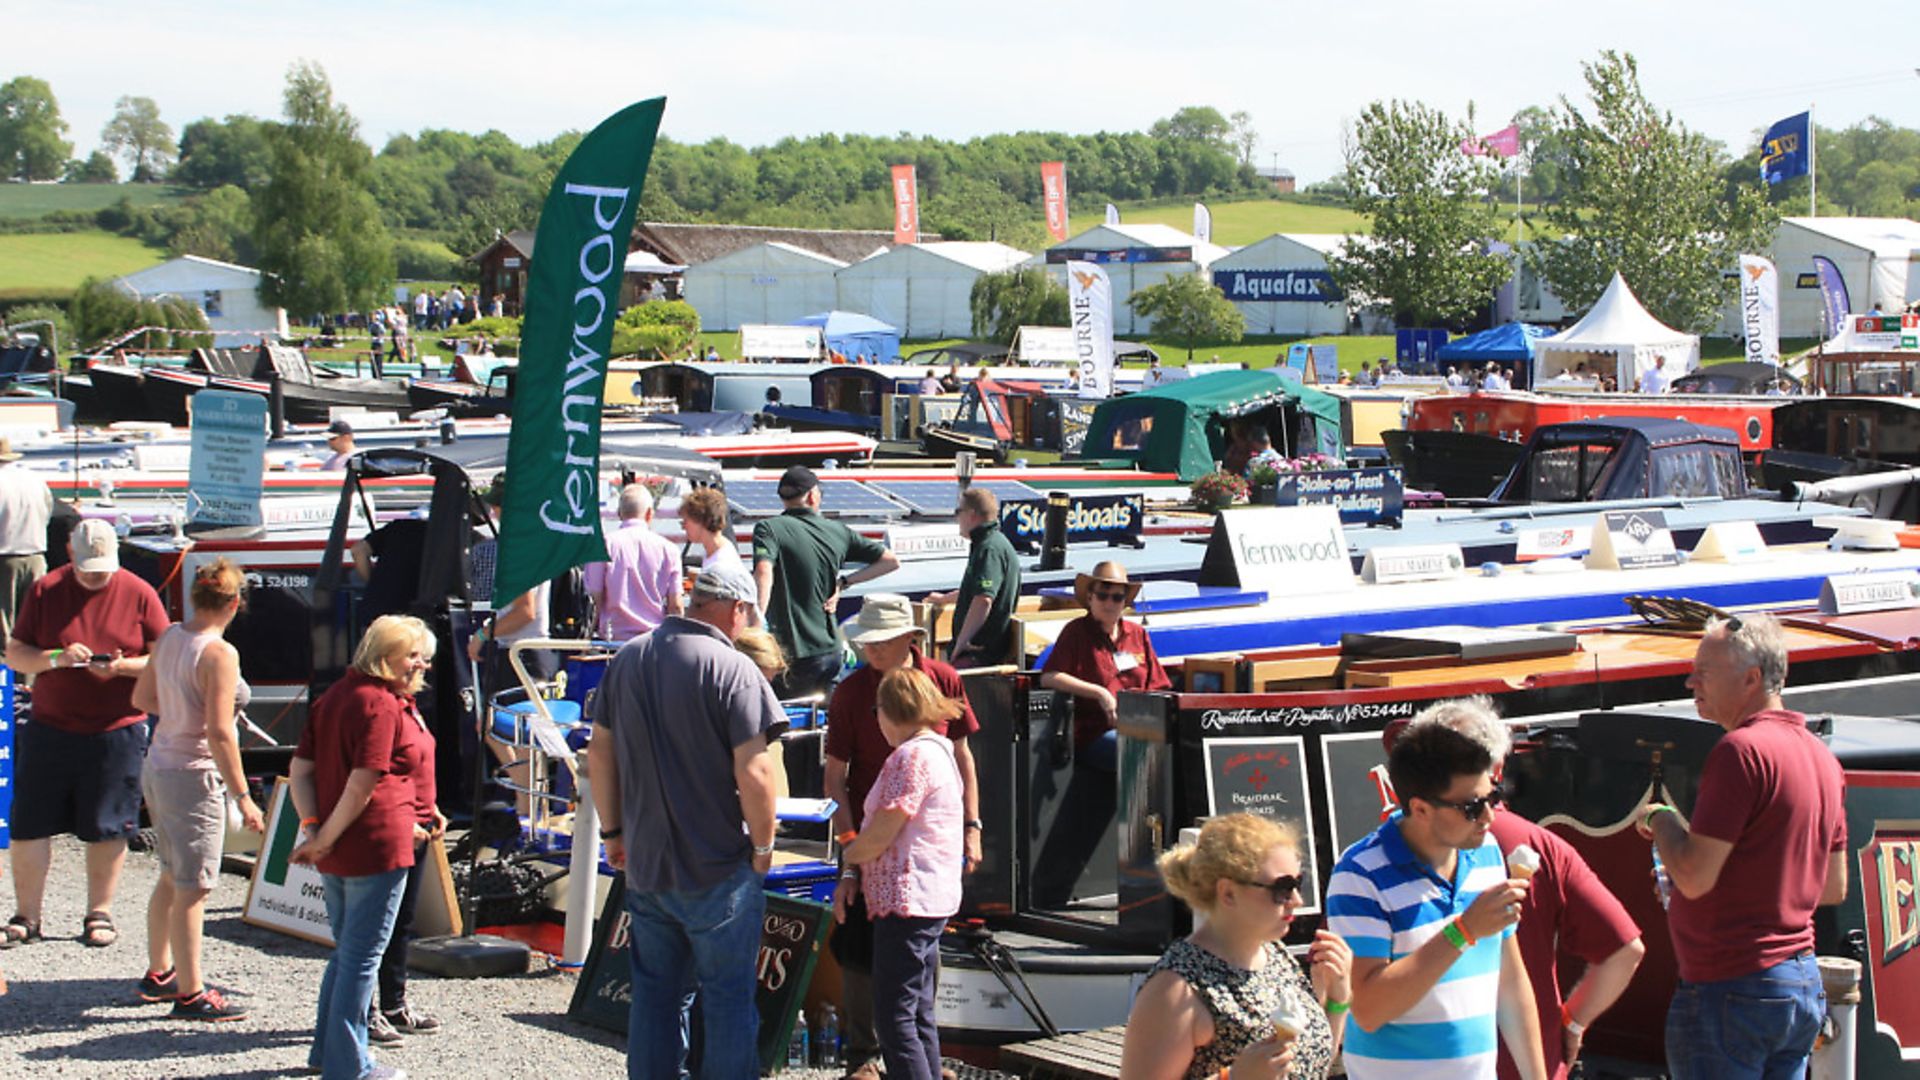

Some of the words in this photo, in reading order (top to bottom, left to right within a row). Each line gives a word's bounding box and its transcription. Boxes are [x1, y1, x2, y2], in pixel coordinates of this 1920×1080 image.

[1232, 273, 1320, 299] Aquafax
[1075, 296, 1097, 389] BOURNE
[540, 183, 630, 535] fernwood
[1296, 472, 1384, 493] Stoke-on-Trent
[1332, 494, 1382, 515] Building
[1017, 501, 1132, 534] Stoeboats
[1239, 528, 1341, 565] fernwood
[266, 575, 309, 588] 524198
[1361, 702, 1413, 719] 524441
[258, 896, 298, 917] Individual
